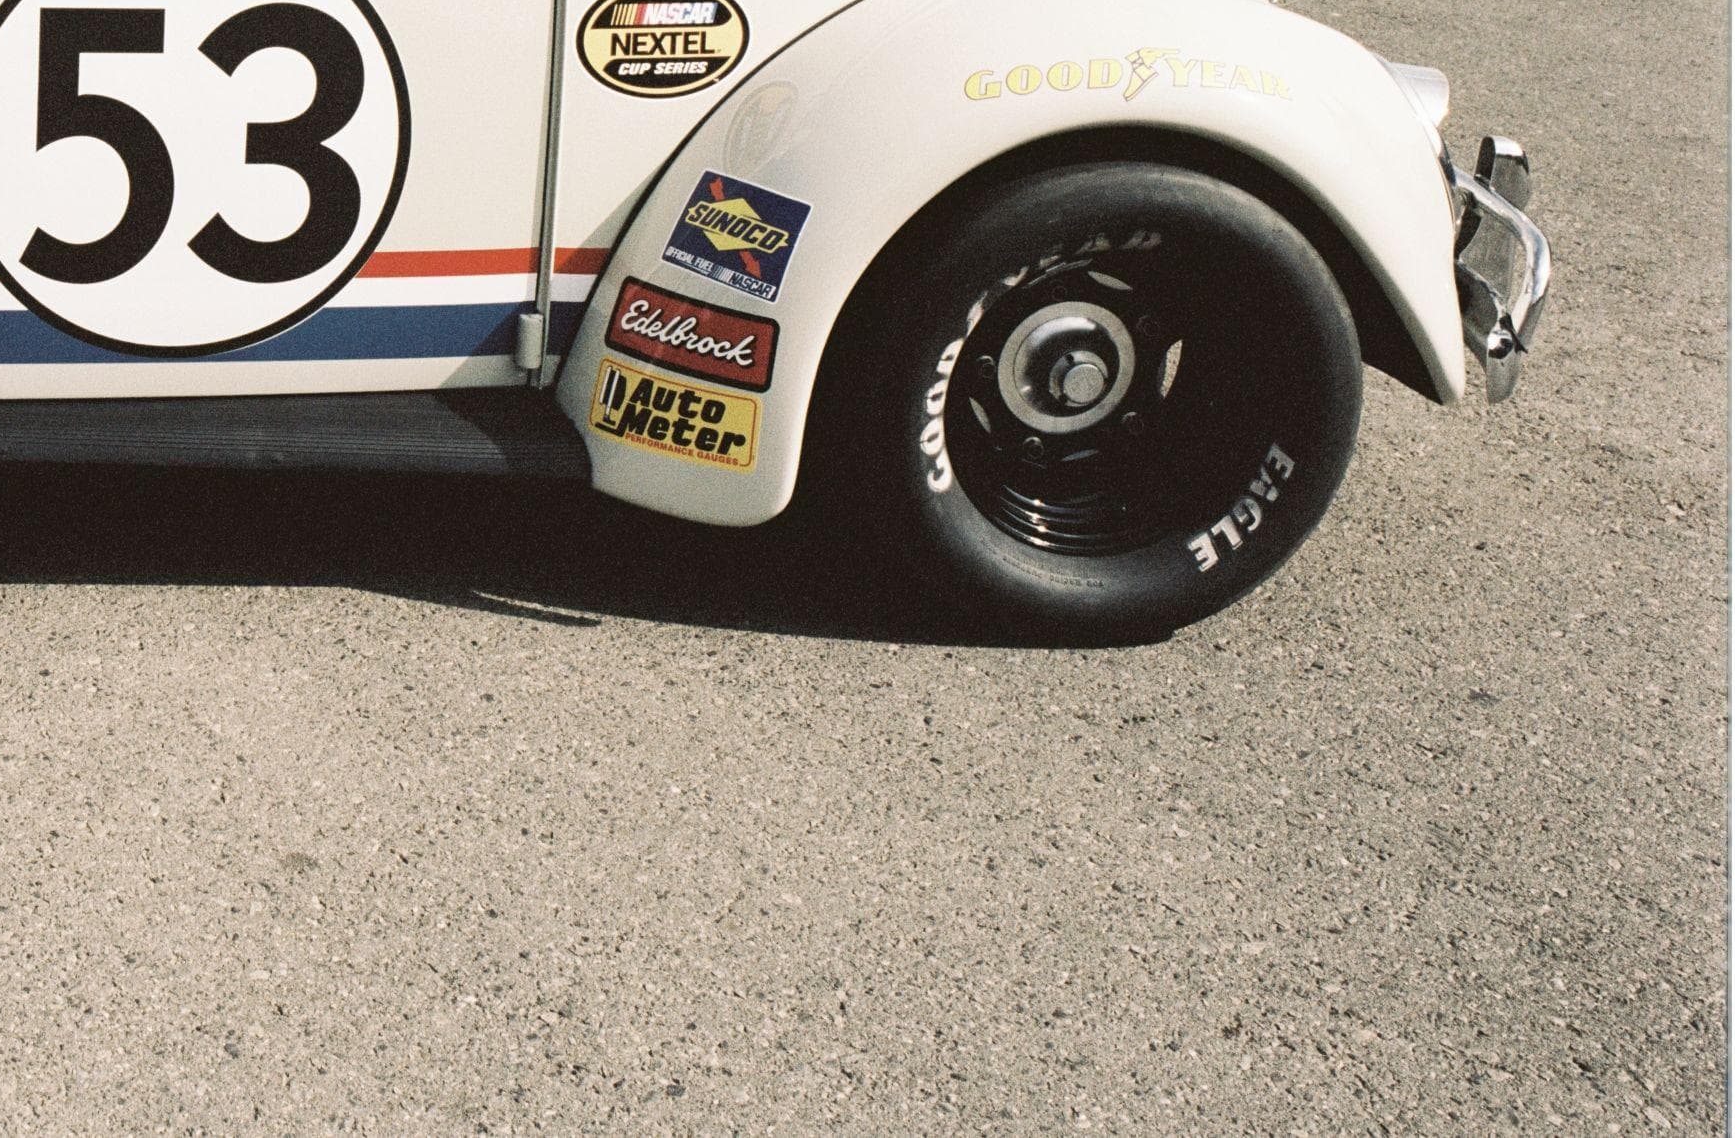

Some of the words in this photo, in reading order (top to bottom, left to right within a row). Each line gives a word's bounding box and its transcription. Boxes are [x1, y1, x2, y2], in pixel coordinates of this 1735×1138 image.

[642, 2, 715, 25] NASCAR
[610, 30, 715, 57] NEXTEL
[617, 61, 651, 76] CUP
[653, 60, 709, 75] SERIES
[18, 1, 366, 285] 53
[687, 201, 785, 250] SUNOCO
[694, 255, 714, 272] FUEL
[728, 271, 774, 299] NASCAR
[620, 300, 754, 367] Edelbrock
[629, 377, 726, 425] Auto
[616, 403, 747, 456] Meter
[624, 432, 694, 457] PERFORMANCE
[697, 450, 739, 466] GAUGES
[1186, 442, 1295, 573] EAGLE
